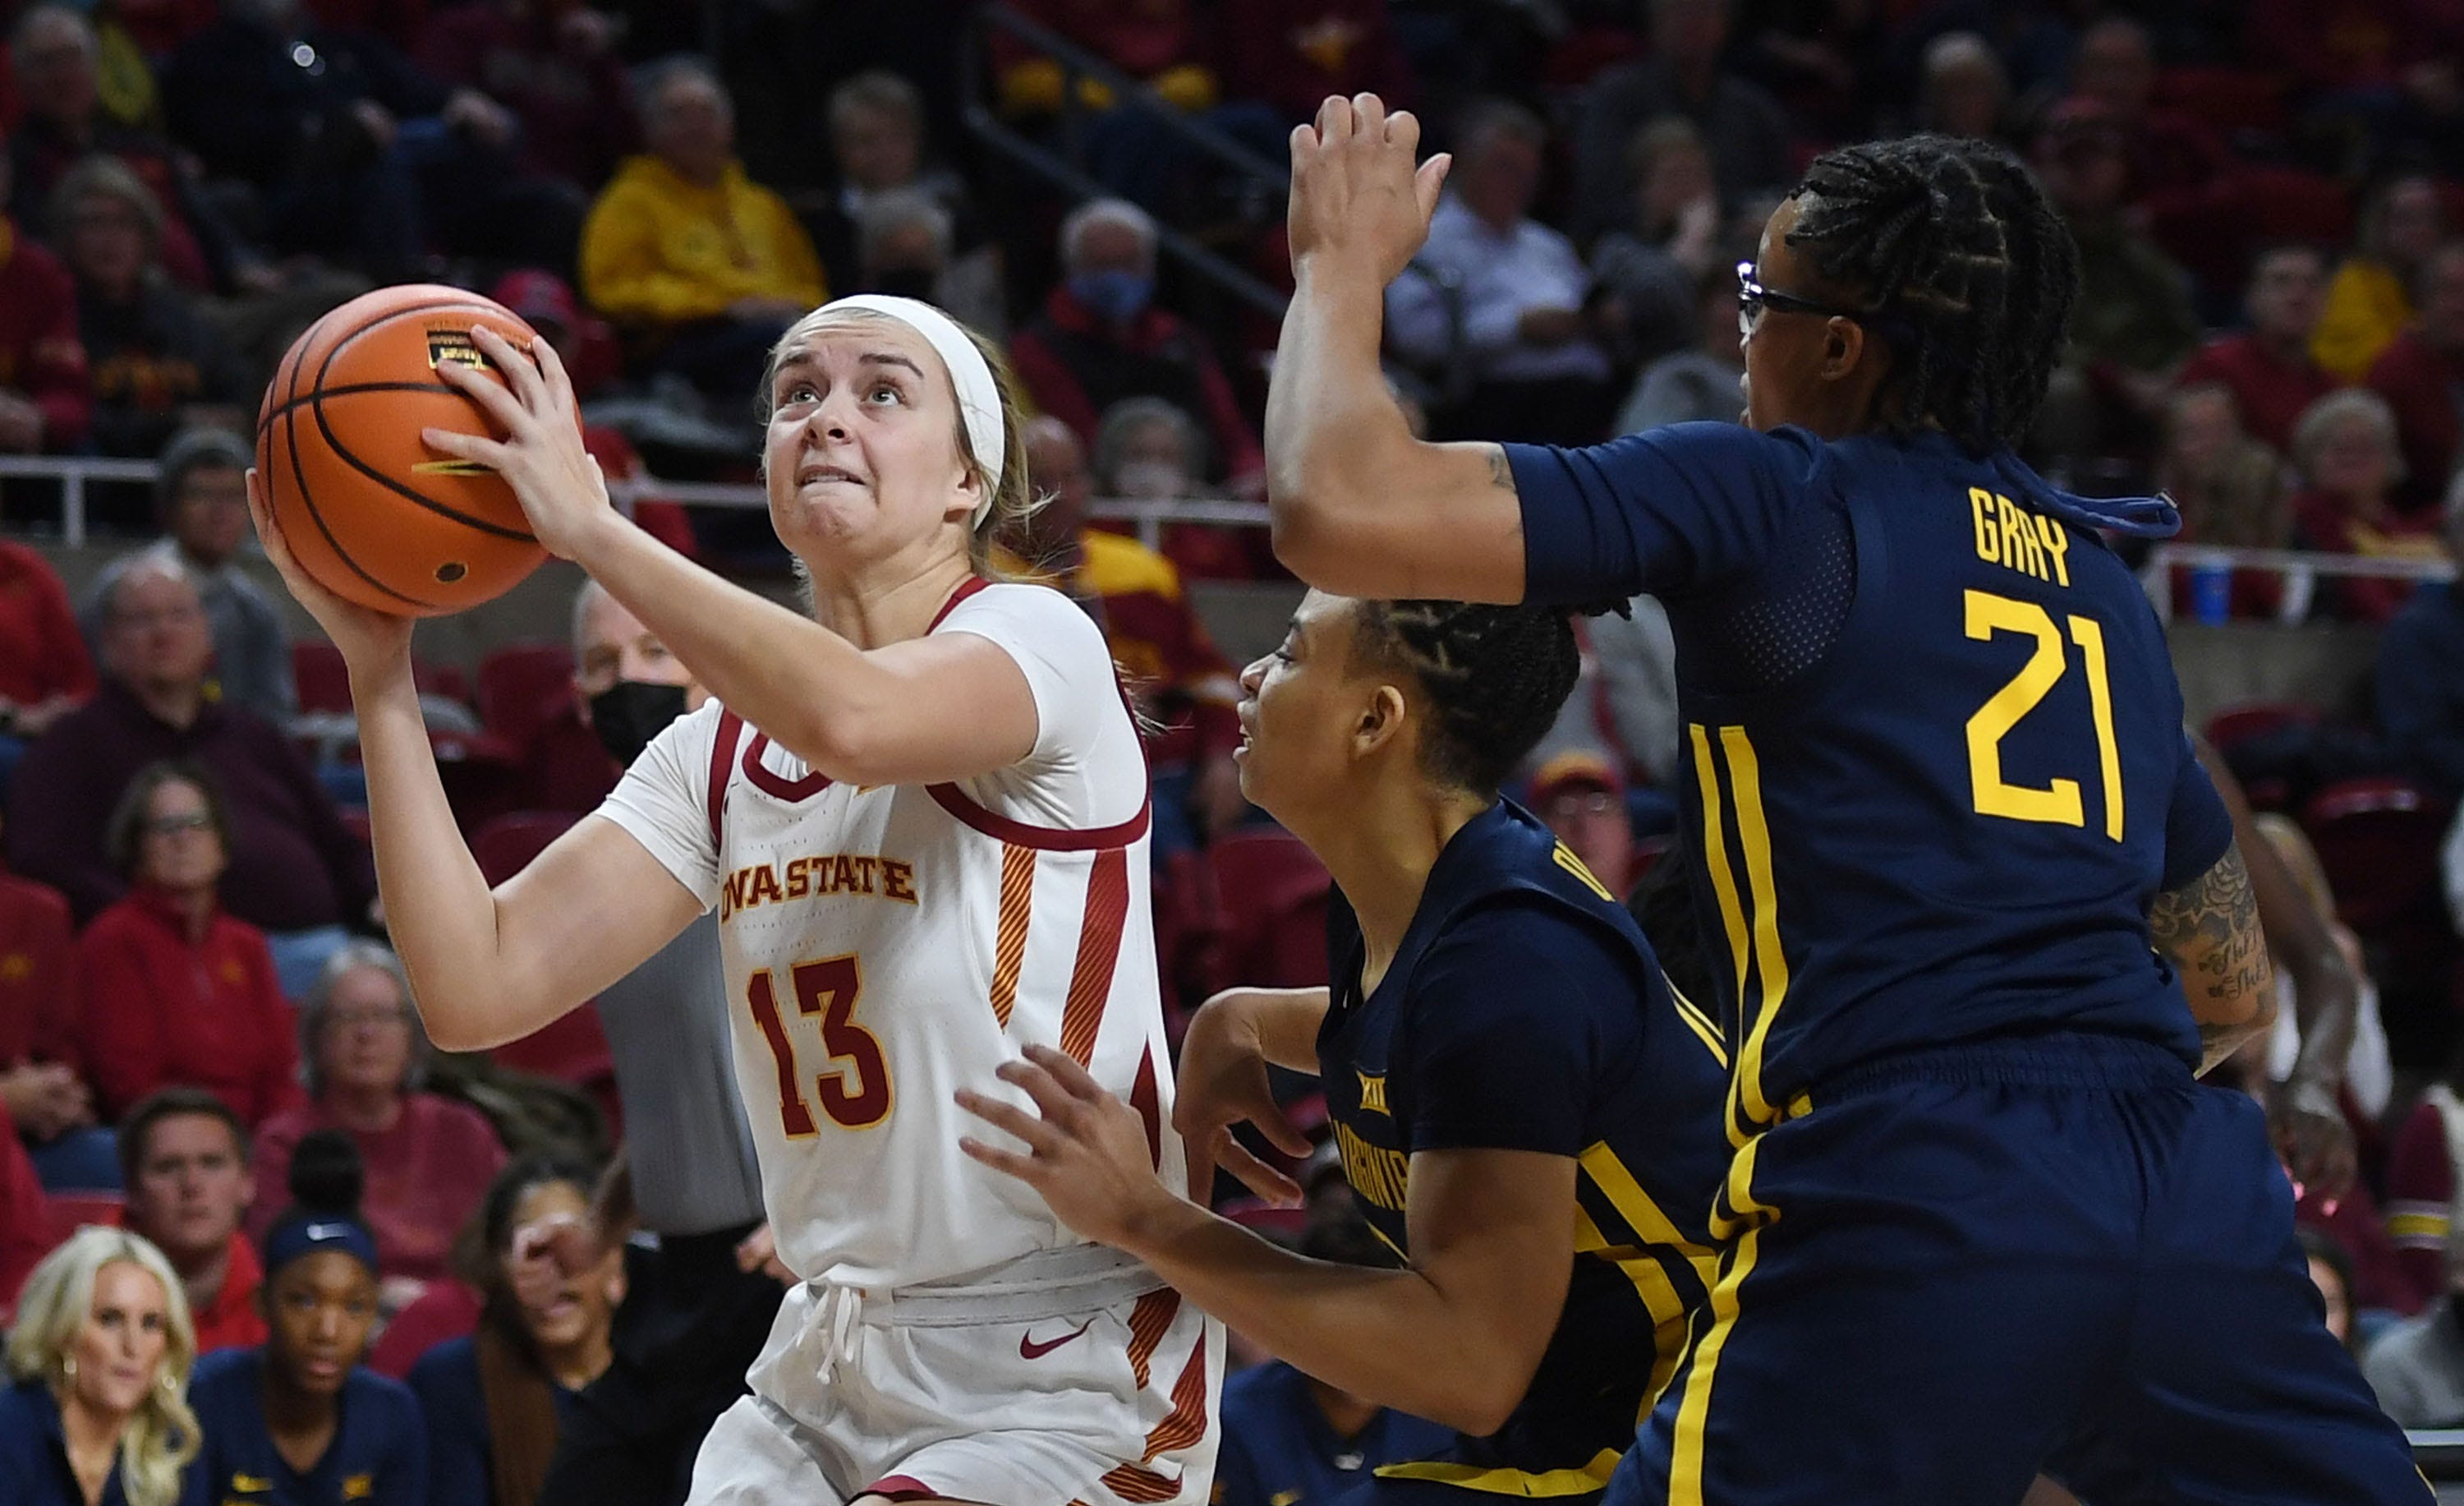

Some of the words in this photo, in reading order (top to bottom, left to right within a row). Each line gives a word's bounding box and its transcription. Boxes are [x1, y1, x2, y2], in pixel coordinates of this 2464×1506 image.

[1969, 486, 2070, 587] GRAY
[1964, 588, 2125, 844] 21
[785, 852, 919, 907] STATE
[746, 951, 895, 1141] 13
